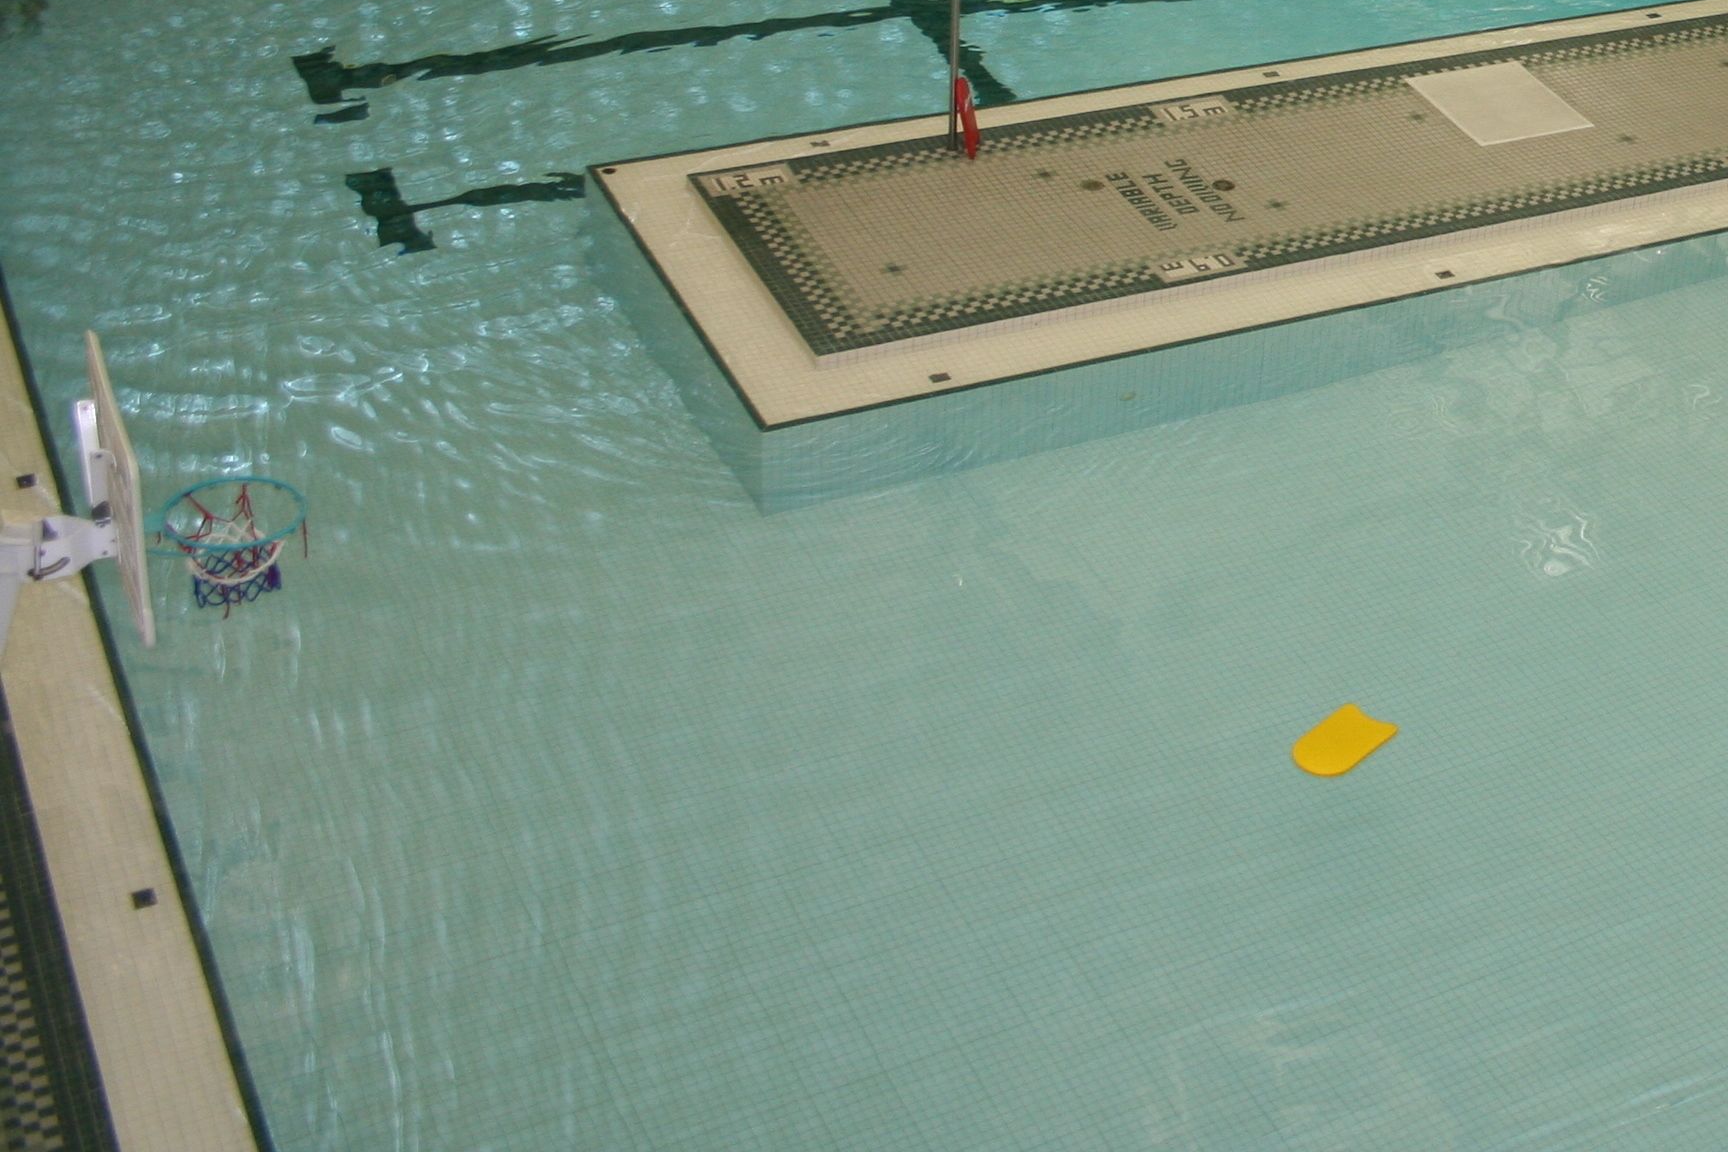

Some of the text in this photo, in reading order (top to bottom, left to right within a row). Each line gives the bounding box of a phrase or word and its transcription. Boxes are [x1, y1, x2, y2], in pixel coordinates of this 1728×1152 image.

[1104, 171, 1179, 232] VARIABLE
[1141, 173, 1201, 216] DEPTH
[1164, 158, 1246, 223] NO DIVING
